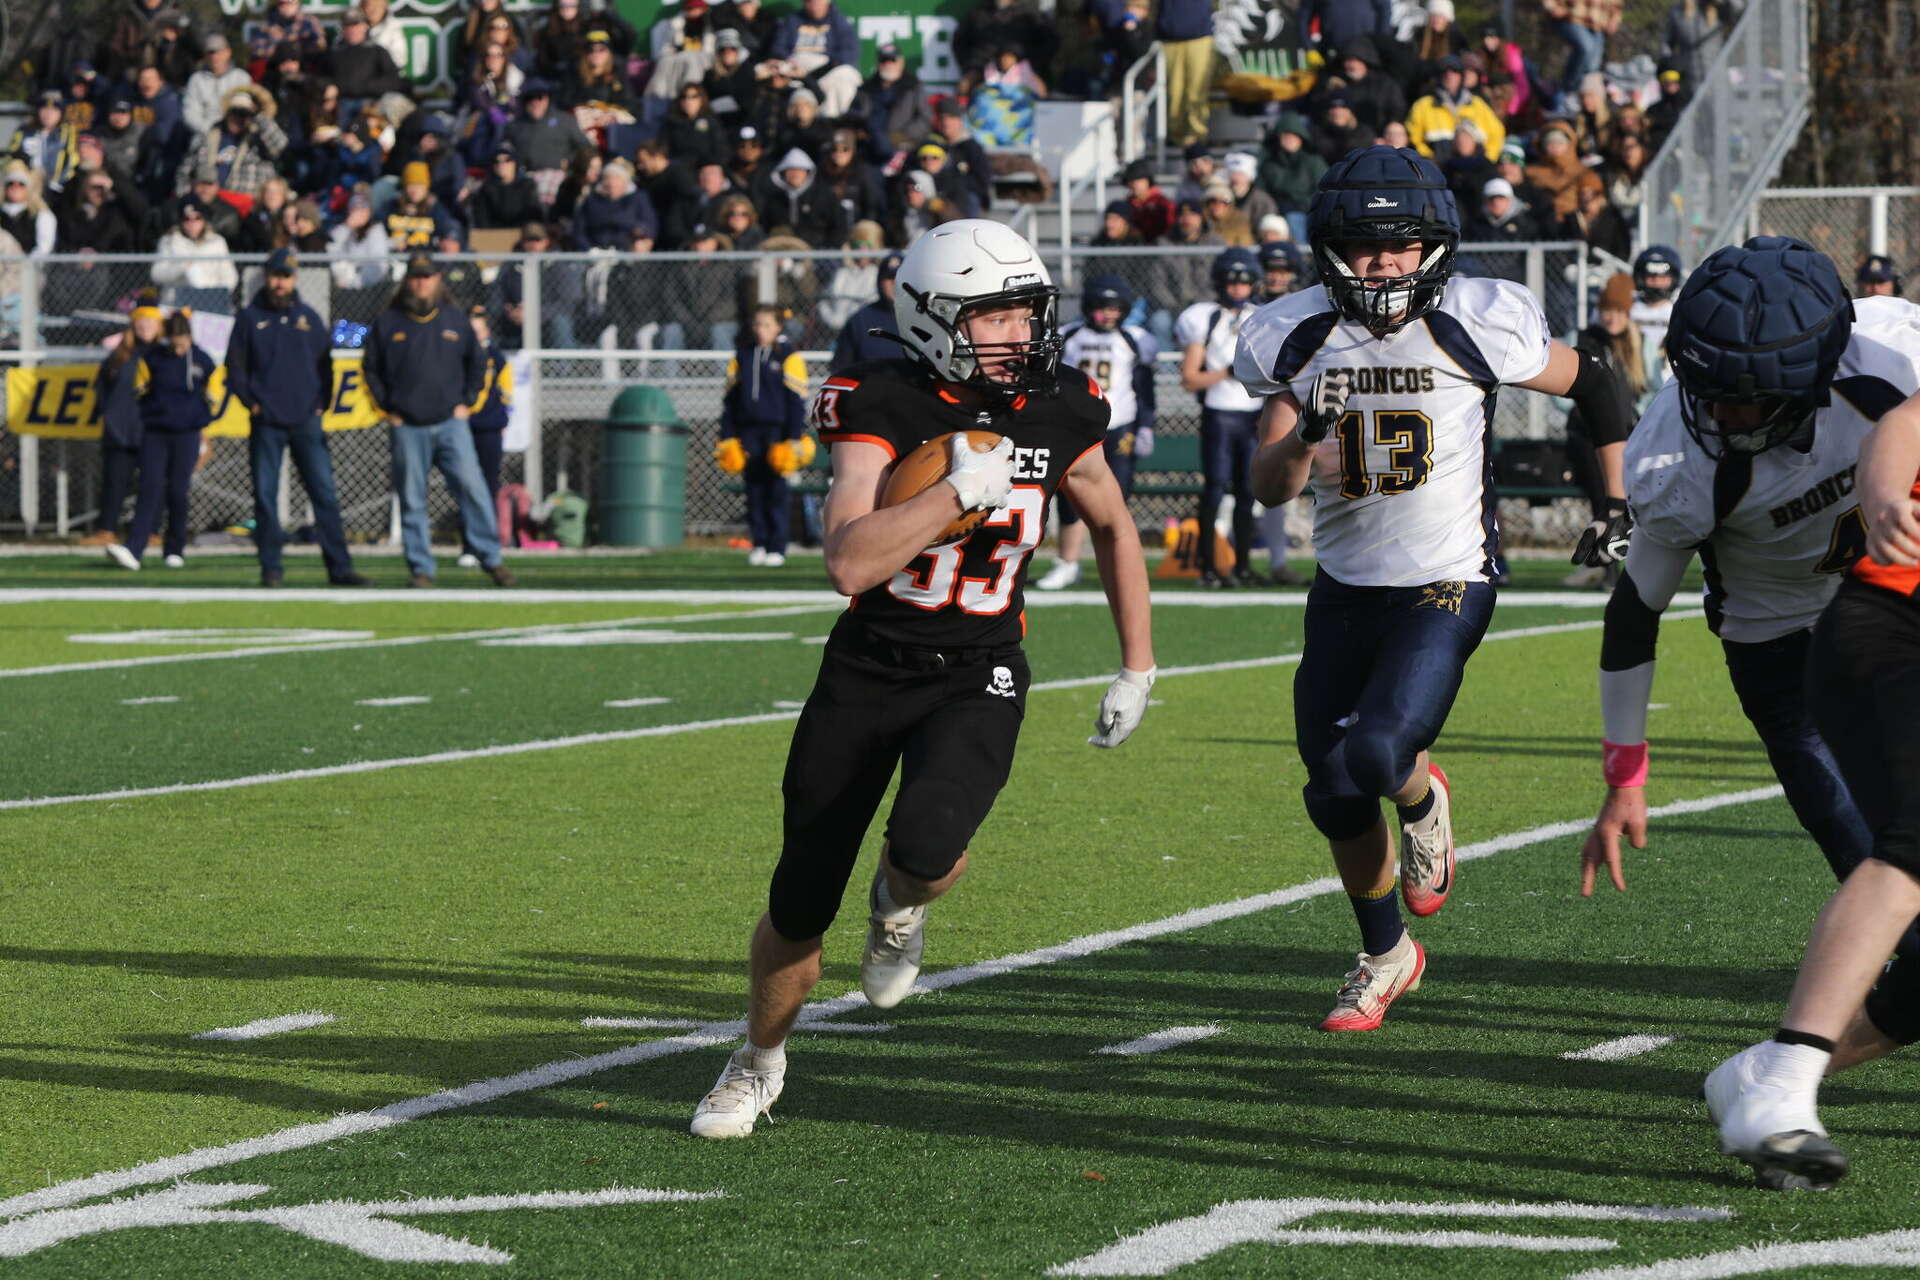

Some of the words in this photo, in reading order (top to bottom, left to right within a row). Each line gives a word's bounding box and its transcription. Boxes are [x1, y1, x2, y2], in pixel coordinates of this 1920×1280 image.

[1376, 223, 1396, 231] VICIS
[1326, 366, 1435, 394] RONCOS
[1335, 409, 1434, 499] 13
